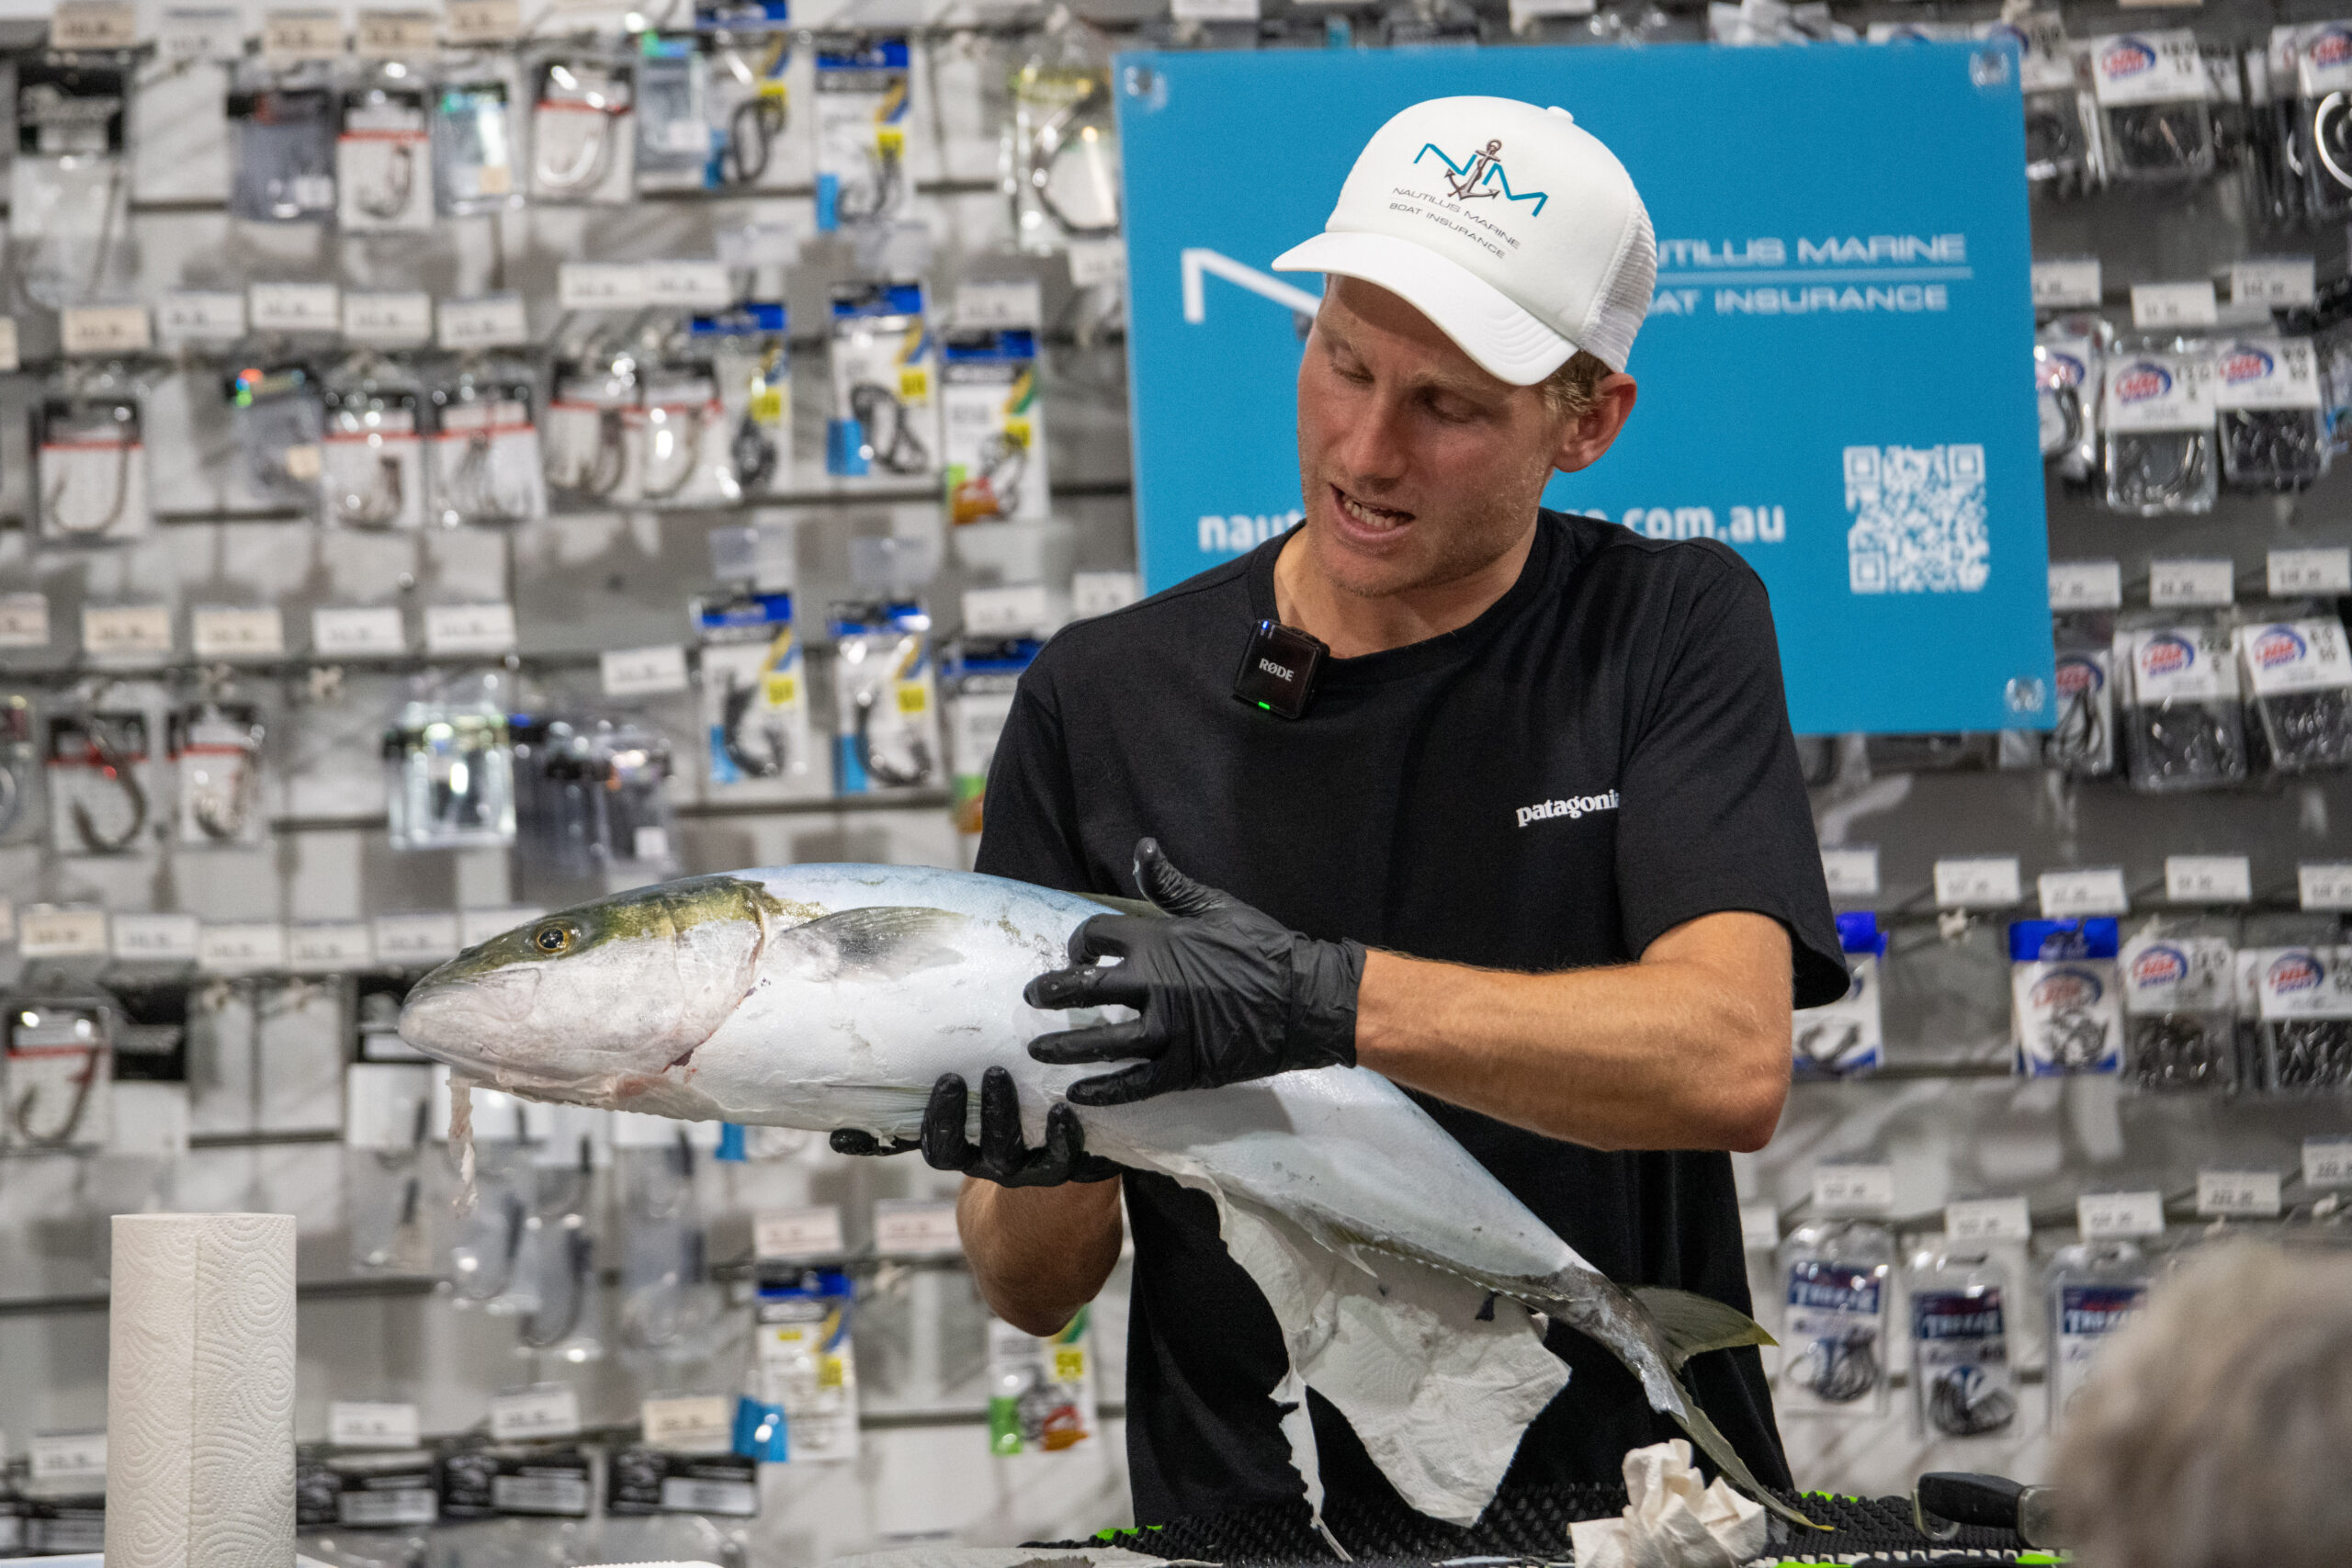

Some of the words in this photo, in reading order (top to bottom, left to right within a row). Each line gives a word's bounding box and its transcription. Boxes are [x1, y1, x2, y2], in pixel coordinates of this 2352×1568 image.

[1389, 202, 1422, 215] BOAT
[1426, 212, 1506, 259] INSURANCE
[1392, 187, 1462, 213] NAUTILUS
[1464, 210, 1521, 250] MARINE
[1797, 233, 1967, 265] MARINE
[1646, 288, 1702, 316] AT
[1713, 285, 1949, 316] INSURANCE
[1259, 658, 1295, 682] RØDE
